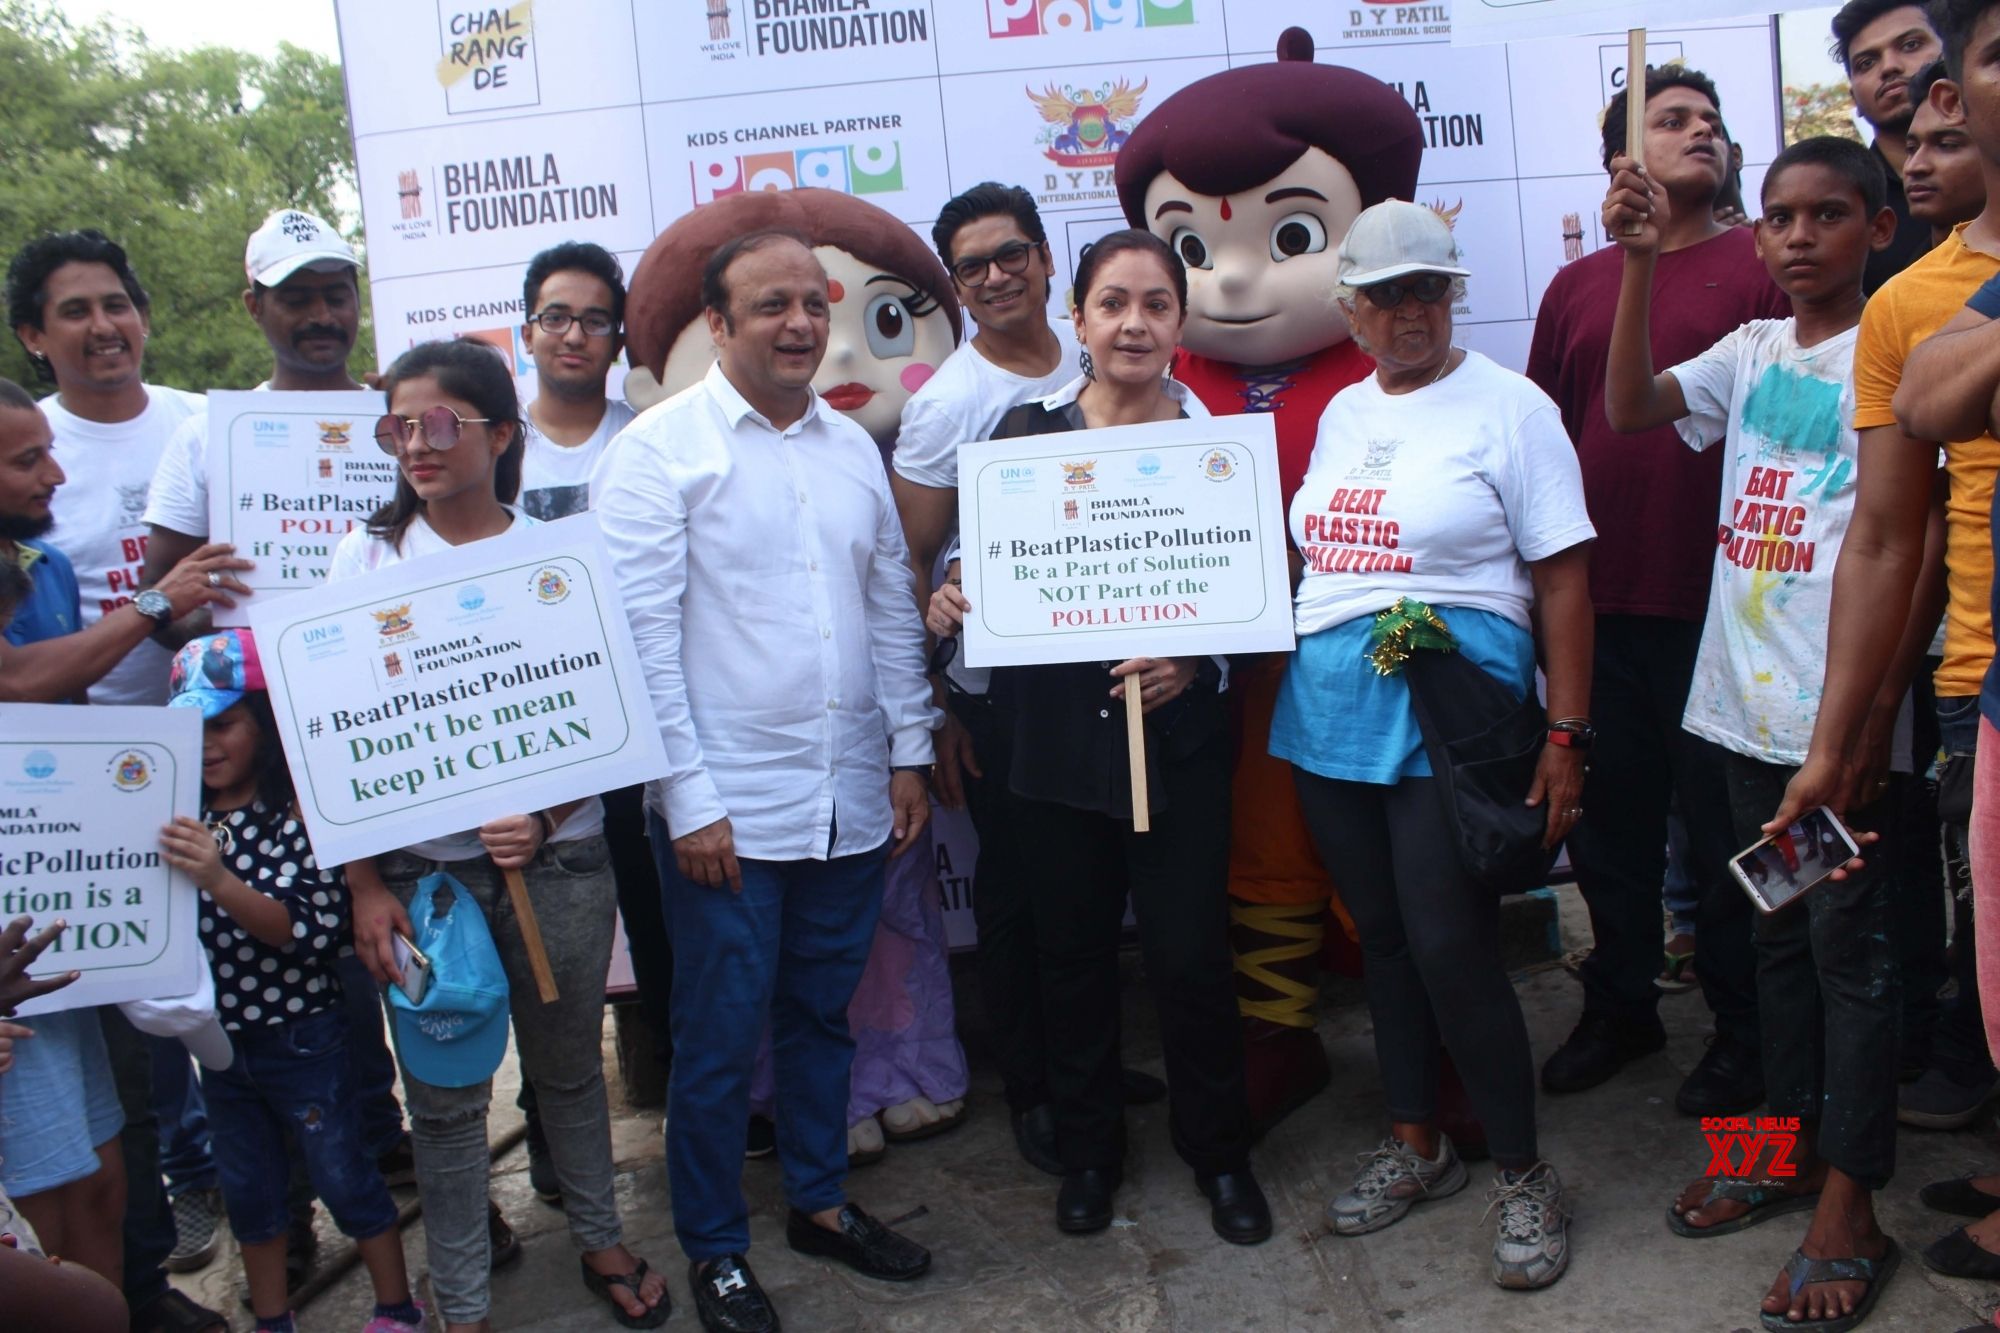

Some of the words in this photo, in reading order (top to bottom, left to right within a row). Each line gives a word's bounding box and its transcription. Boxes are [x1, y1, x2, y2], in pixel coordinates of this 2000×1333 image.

[450, 8, 522, 35] CHAL
[1349, 10, 1362, 26] D
[1370, 8, 1387, 25] Y
[1396, 6, 1450, 24] PATIL
[756, 9, 928, 56] FOUNDATION
[1342, 27, 1420, 39] INTERNATIONAL
[1423, 24, 1452, 34] SCHOO
[450, 35, 529, 66] RANG
[700, 43, 716, 52] WE
[717, 41, 742, 50] LOVE
[710, 52, 736, 61] INDIA
[473, 64, 508, 91] DE
[687, 131, 728, 148] KIDS
[734, 122, 819, 143] CHANNEL
[824, 114, 903, 135] PARTNER
[443, 152, 561, 198] BHAMLA
[1044, 173, 1058, 191] D
[1066, 171, 1084, 189] Y
[447, 183, 618, 234] FOUNDATION
[1036, 189, 1119, 204] INTERNATIONAL
[402, 232, 427, 241] INDIA
[409, 220, 432, 230] LOVE
[406, 307, 447, 325] KIDS
[452, 298, 527, 319] CHANNE
[253, 421, 274, 432] UN
[344, 474, 396, 484] FOUND
[1000, 467, 1020, 480] UN
[239, 493, 253, 511] #
[1090, 497, 1151, 510] BHAMLA
[1091, 507, 1185, 522] FOUNDATION
[1328, 488, 1387, 515] BEAT
[988, 540, 1002, 559] #
[1010, 525, 1252, 559] BeatPlasticPollution
[1304, 514, 1400, 550] PLASTIC
[253, 541, 273, 557] if
[281, 545, 329, 561] you
[281, 564, 299, 580] it
[1013, 564, 1040, 581] Be
[1047, 568, 1058, 580] a
[1065, 561, 1111, 578] Part
[1117, 557, 1139, 575] of
[1144, 552, 1231, 573] Solution
[1038, 584, 1091, 604] NOT
[1098, 582, 1144, 601] Part
[1149, 579, 1171, 597] of
[1176, 578, 1209, 595] the
[1051, 602, 1199, 628] POLLUTION
[303, 627, 327, 643] UN
[413, 634, 482, 660] BHAMLA
[416, 639, 523, 675] FOUNDATION
[306, 716, 324, 740] #
[329, 650, 603, 734] BeatPlasticPollution
[347, 720, 438, 764] Don't
[445, 712, 483, 738] be
[493, 687, 578, 726] mean
[348, 757, 426, 802] keep
[433, 754, 459, 782] it
[465, 716, 593, 771] CLEAN
[0, 847, 161, 878] icPollution
[2, 885, 73, 915] tion
[86, 881, 112, 909] is
[125, 886, 142, 906] a
